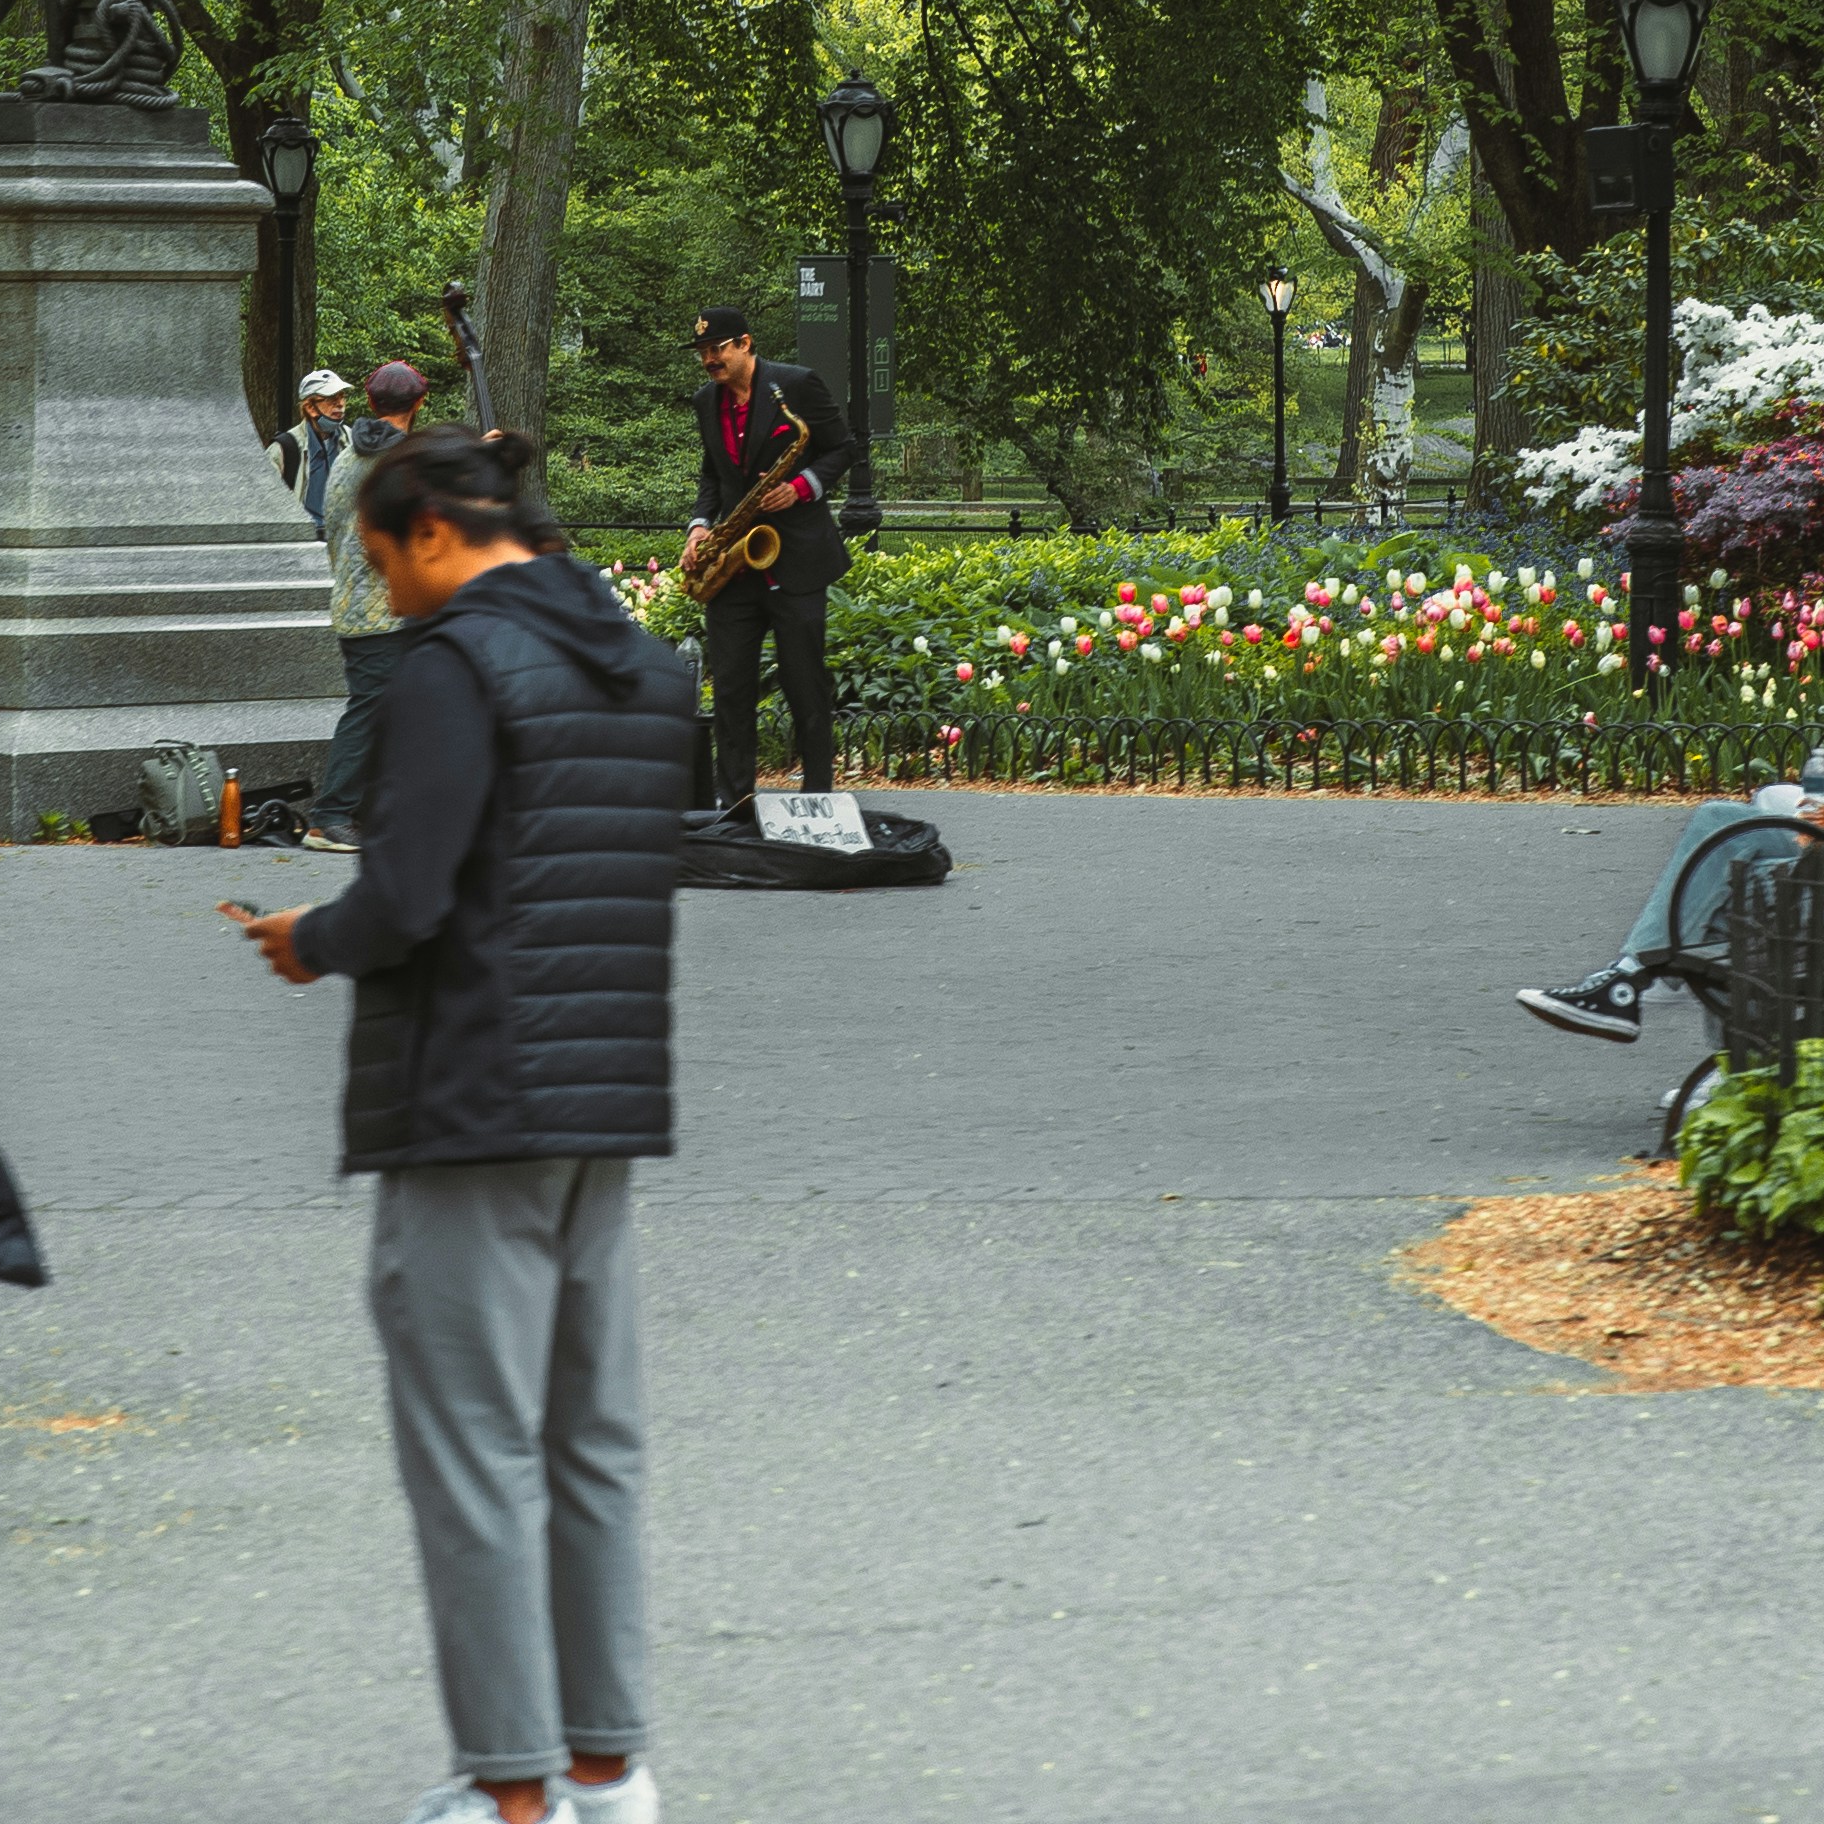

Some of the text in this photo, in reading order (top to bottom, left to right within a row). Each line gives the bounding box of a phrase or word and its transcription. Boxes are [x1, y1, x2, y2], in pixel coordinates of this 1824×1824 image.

[800, 267, 816, 282] THE
[800, 281, 825, 297] DAIRY
[779, 796, 834, 818] VENMO
